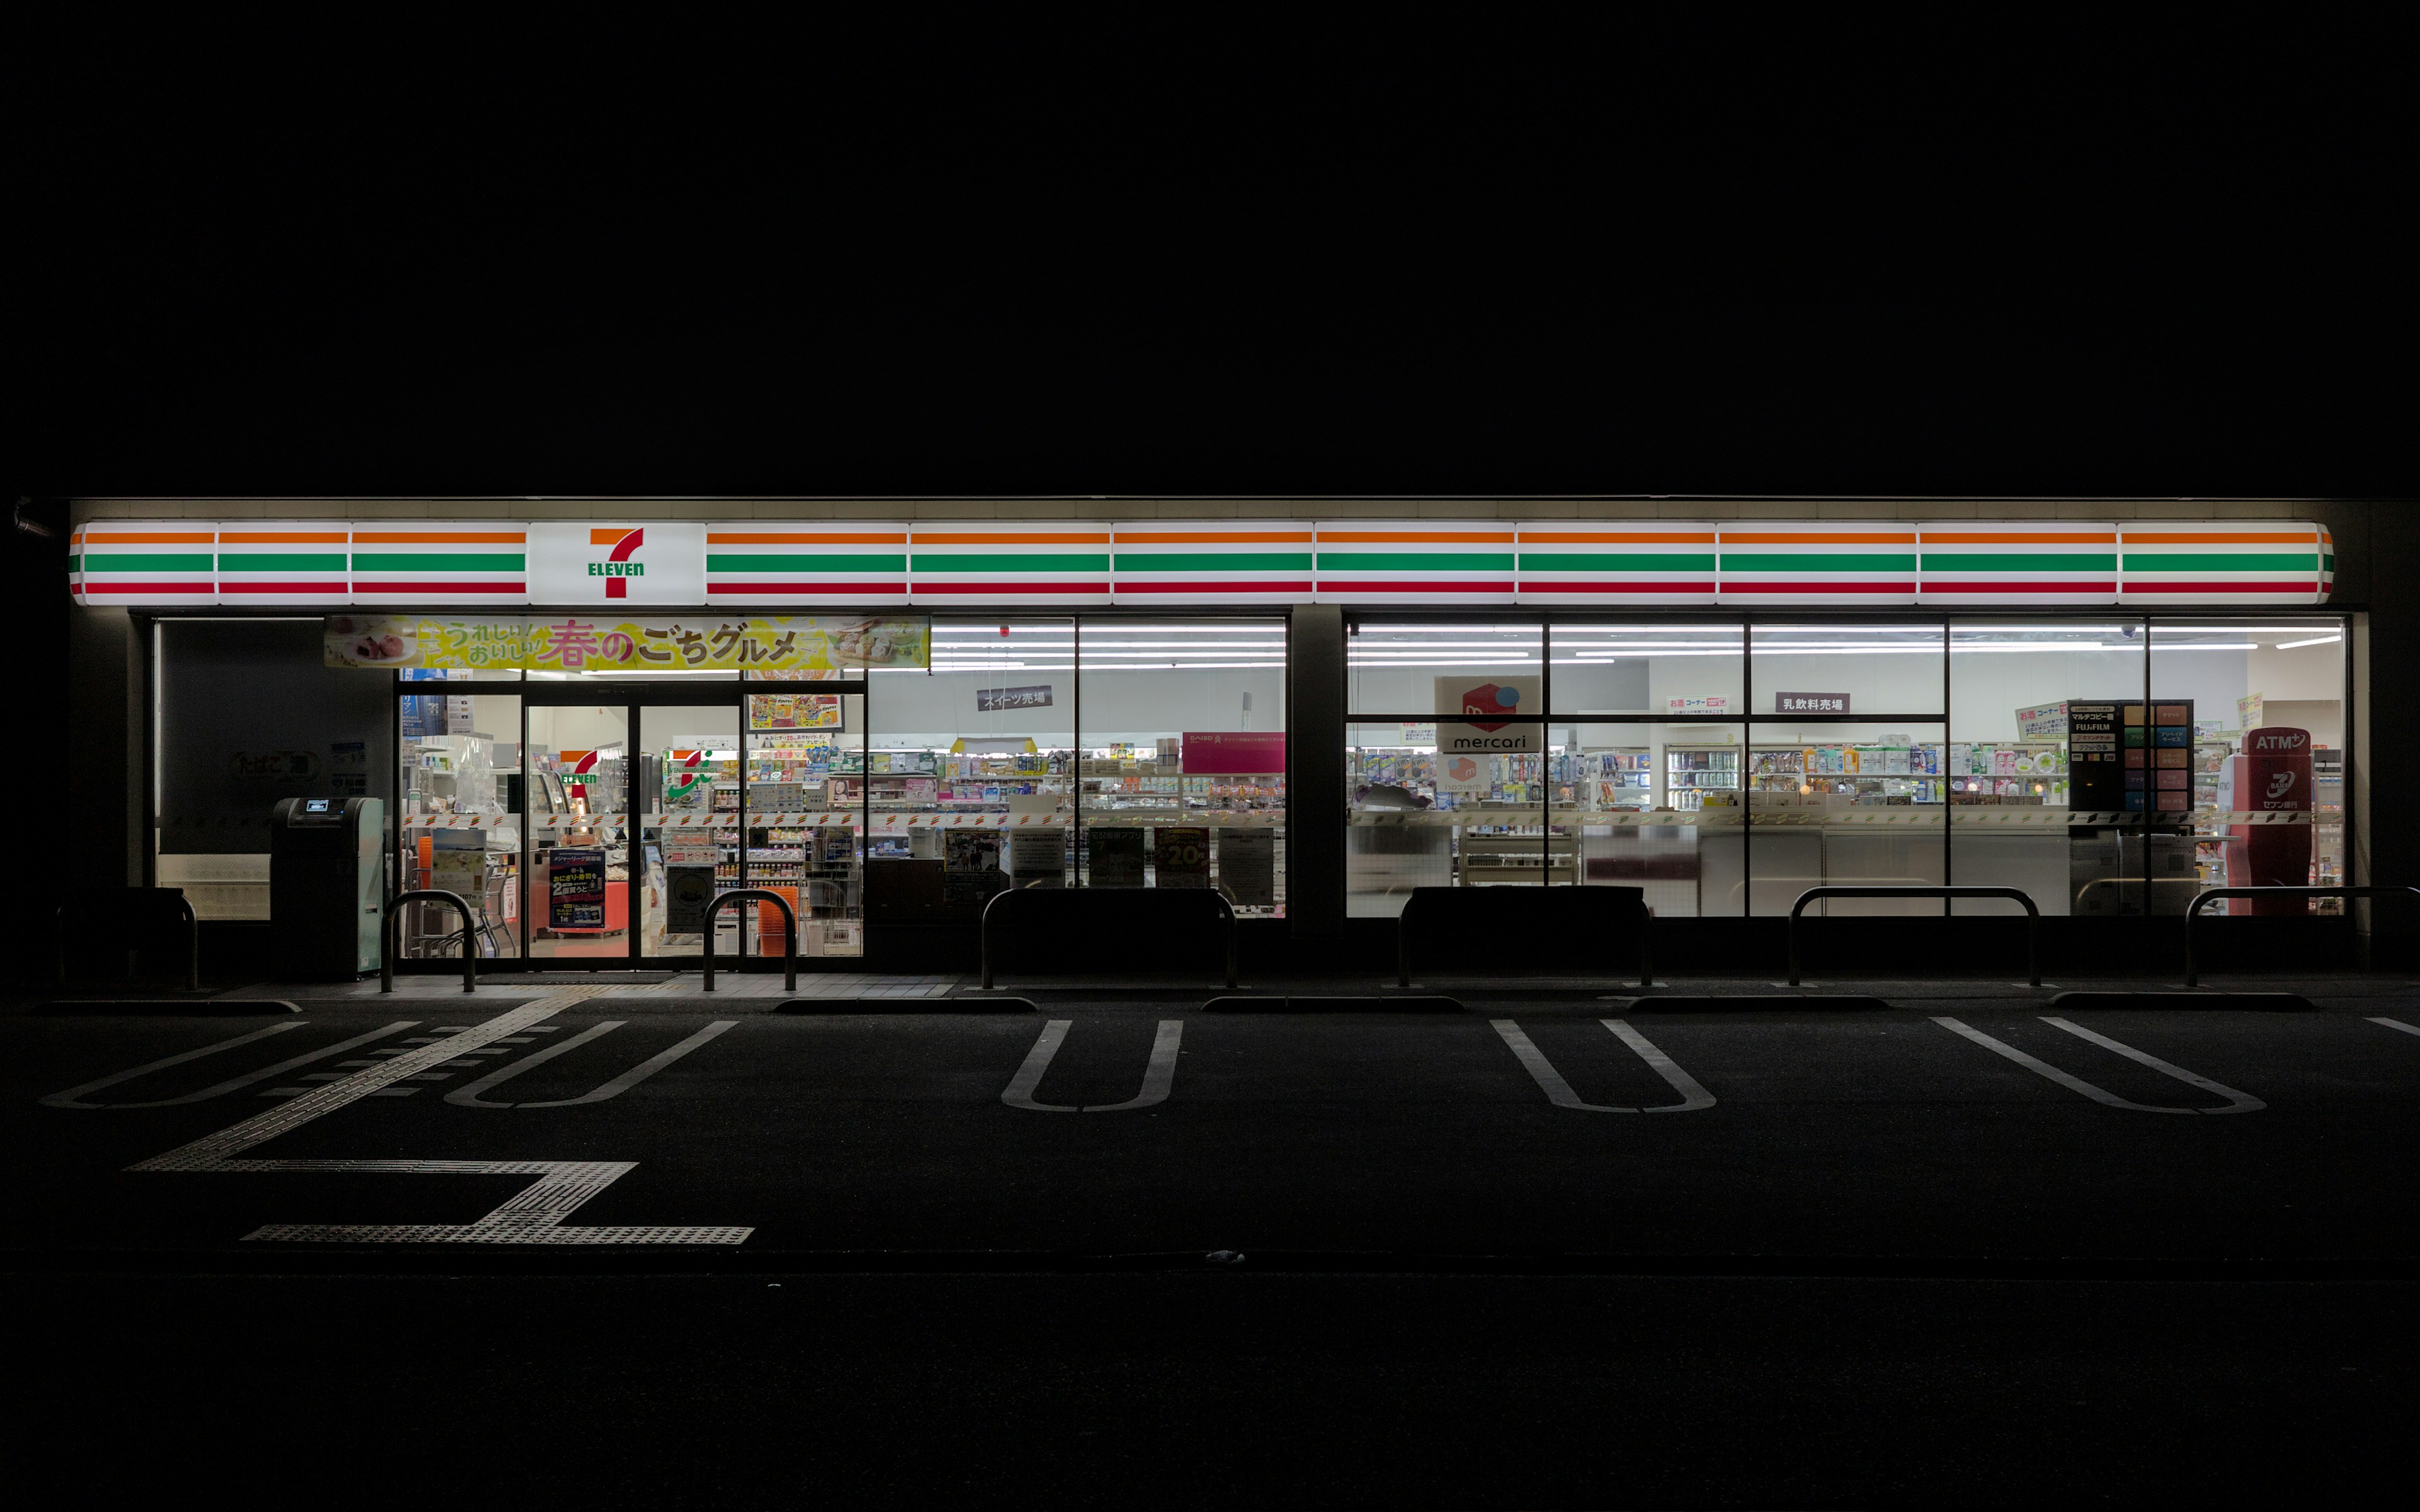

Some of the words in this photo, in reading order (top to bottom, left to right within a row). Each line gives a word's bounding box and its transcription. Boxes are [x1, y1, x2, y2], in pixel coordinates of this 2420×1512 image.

[538, 619, 795, 667] 春のごちグルメ
[984, 692, 1046, 707] スイーツ売場
[1783, 699, 1843, 710] 乳飲料売場
[2020, 710, 2036, 721] お酒
[2037, 708, 2058, 716] コーナー
[1455, 735, 1526, 748] mercari
[2256, 736, 2292, 749] ATM
